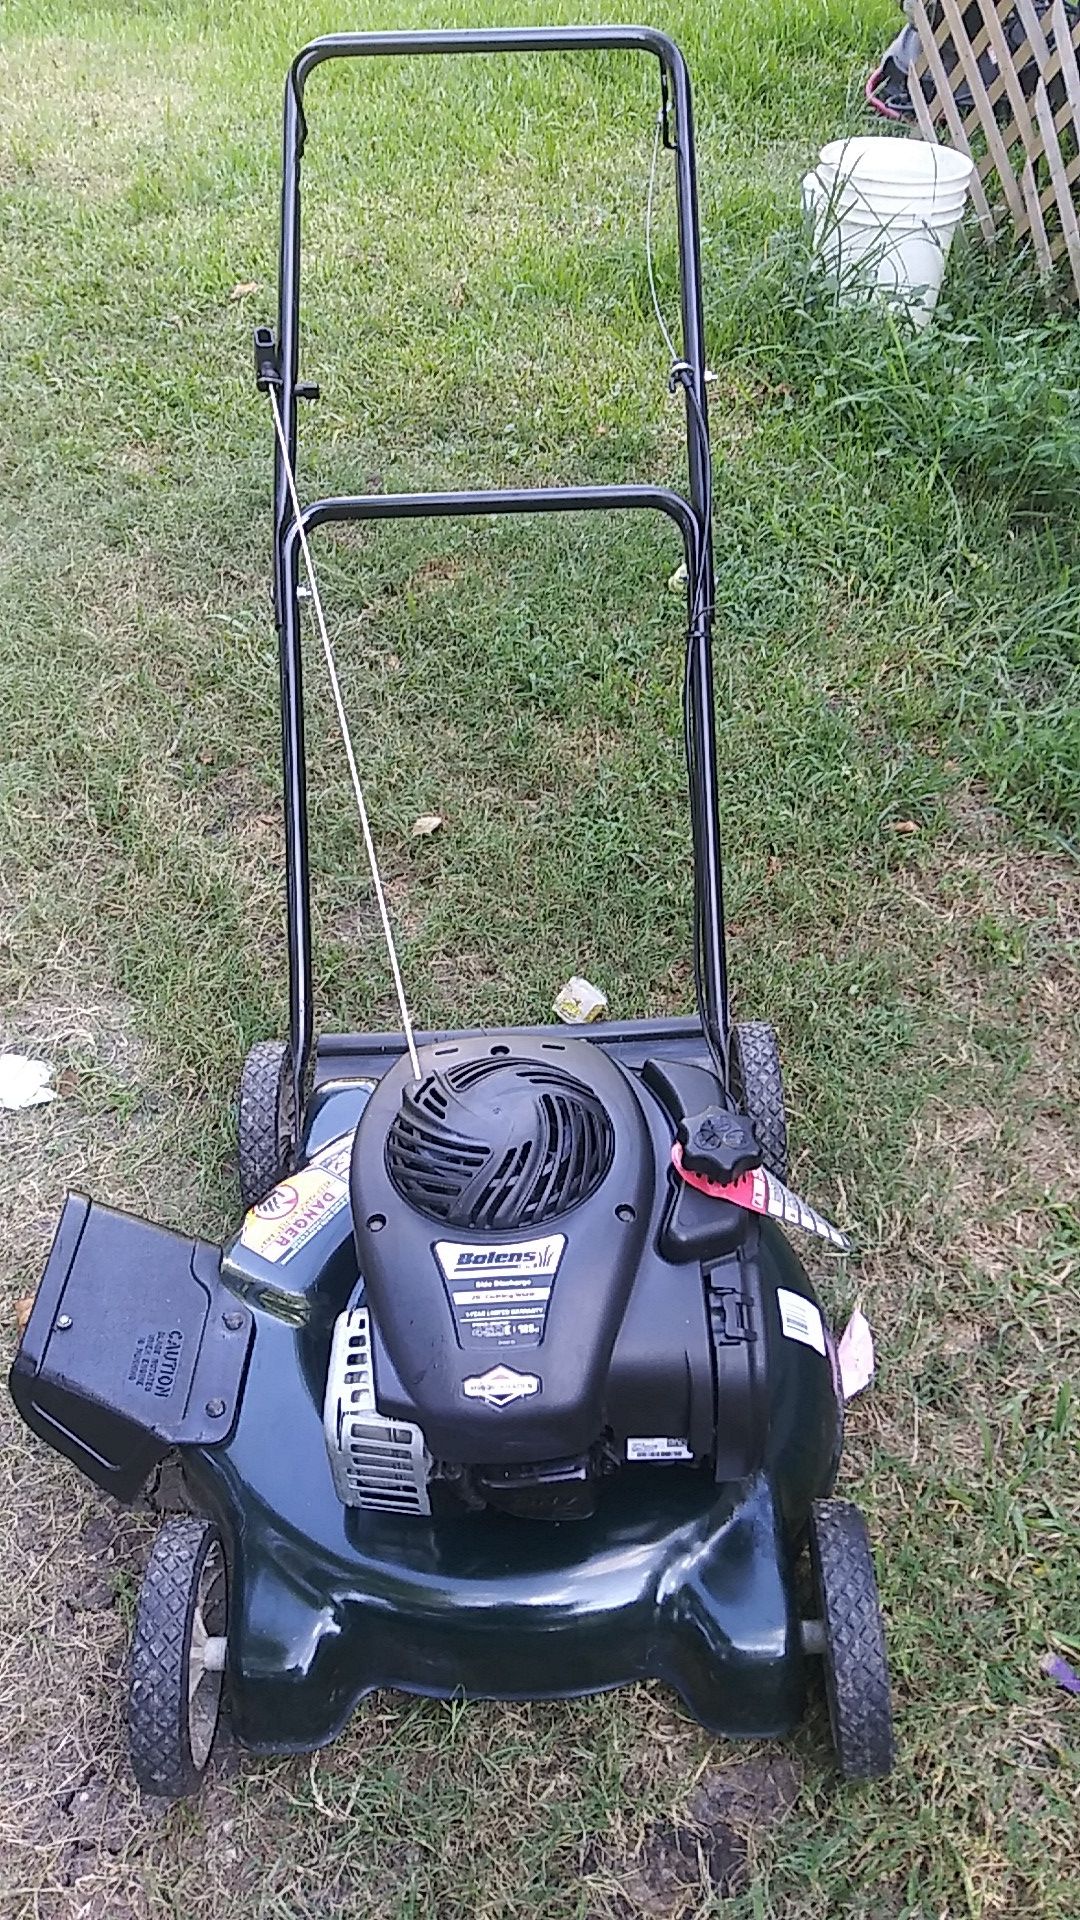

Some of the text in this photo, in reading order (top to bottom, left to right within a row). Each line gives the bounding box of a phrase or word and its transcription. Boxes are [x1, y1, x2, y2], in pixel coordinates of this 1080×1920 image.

[274, 1191, 336, 1246] DANGER
[456, 1251, 537, 1266] Bolens
[154, 1330, 183, 1397] CAUTION
